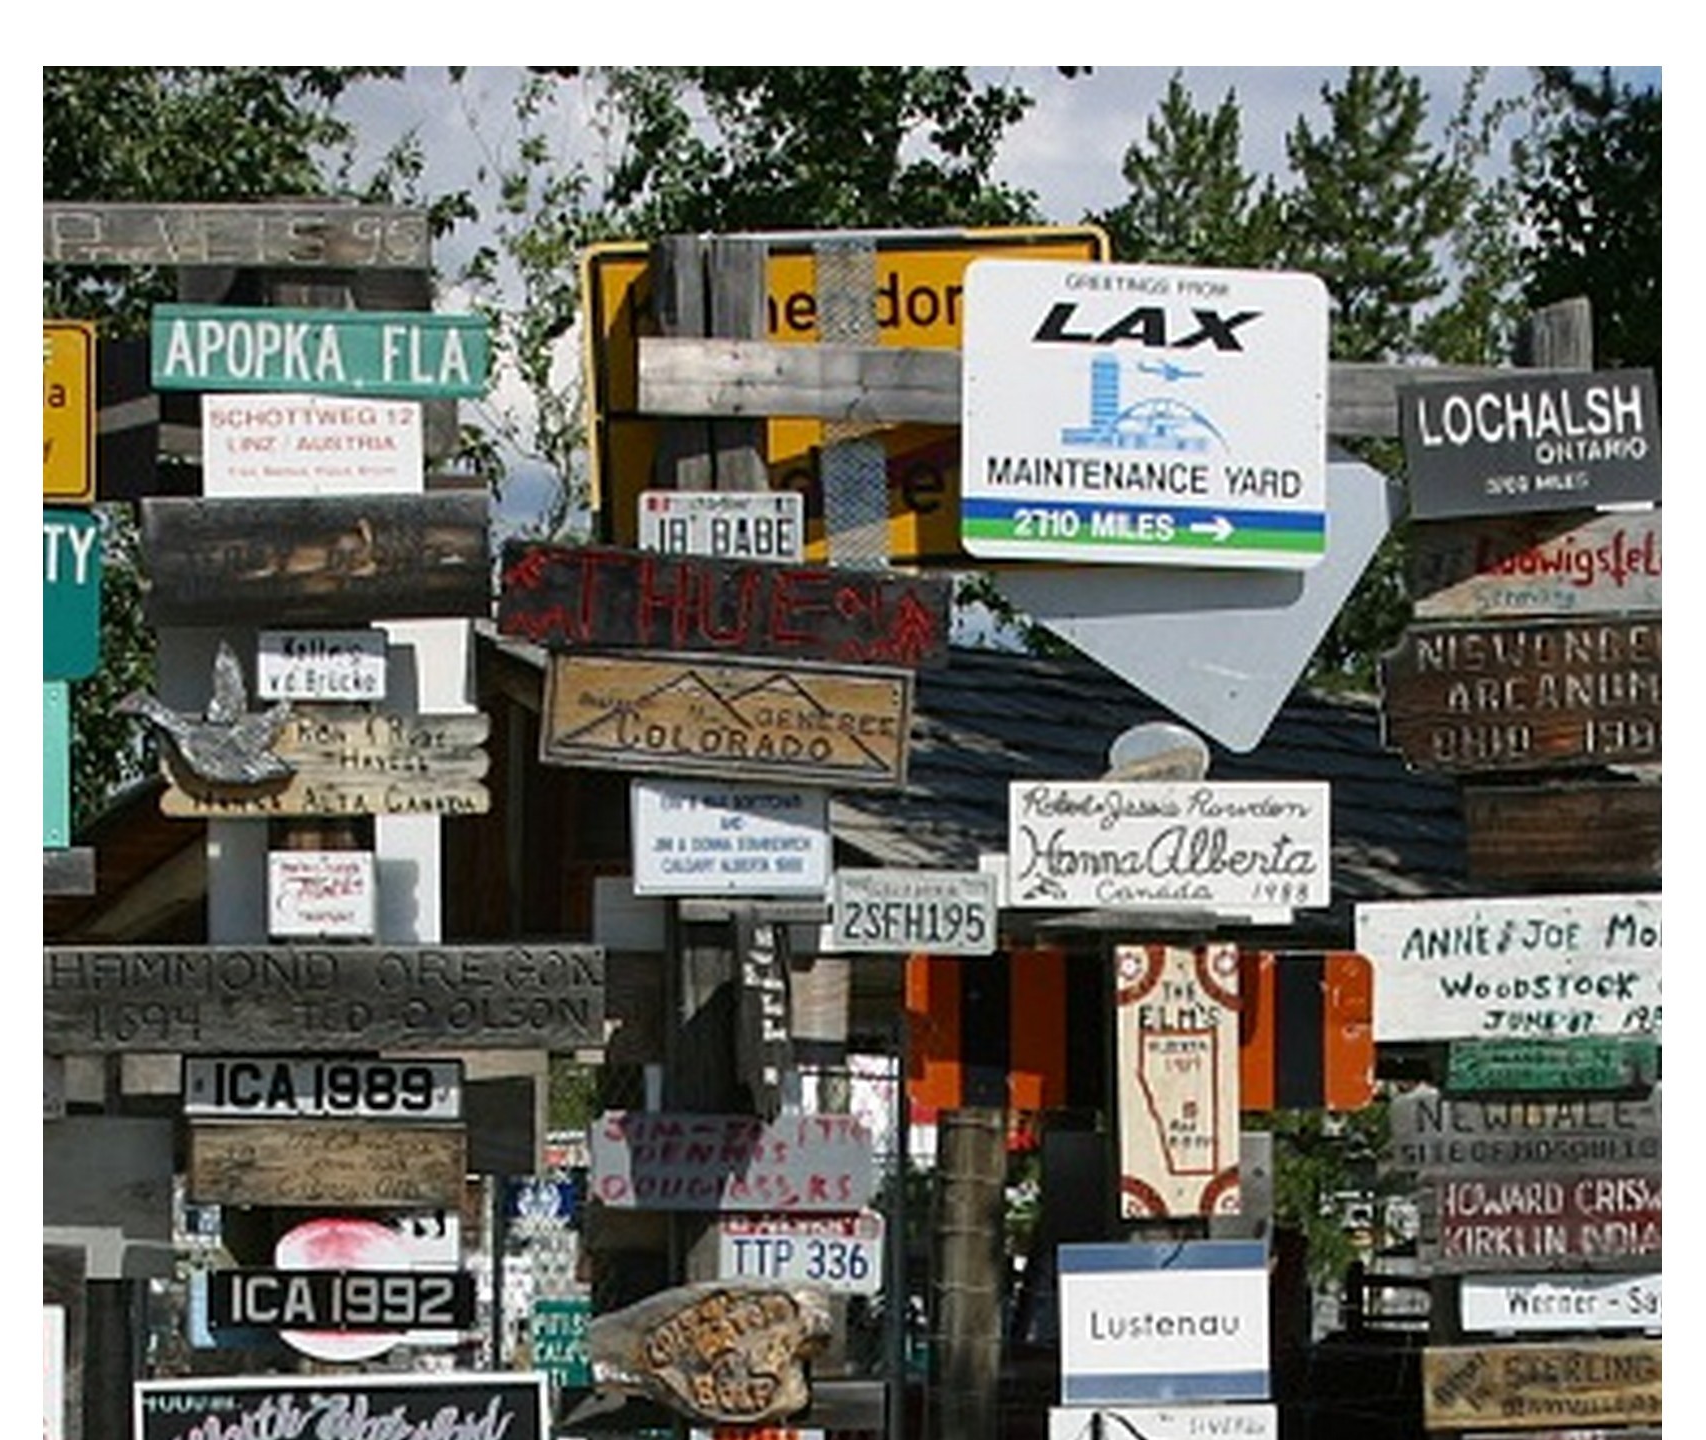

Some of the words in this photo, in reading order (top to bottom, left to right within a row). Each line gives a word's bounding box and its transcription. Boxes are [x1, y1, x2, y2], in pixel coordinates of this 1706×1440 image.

[1031, 302, 1264, 352] LAX
[383, 326, 471, 386] FLA
[1418, 384, 1643, 446] LOCHALSH
[1536, 436, 1648, 465] ONTARIO
[987, 457, 1208, 494] MAINTENANCE
[1225, 466, 1303, 498] YARD
[1013, 508, 1079, 537] 2710
[1090, 511, 1175, 541] MILES
[615, 708, 834, 763] COLORADO
[1146, 825, 1317, 876] Alberta
[1402, 924, 1490, 960] ANNE
[1522, 918, 1581, 950] JOE
[213, 1063, 301, 1109] ICA
[314, 1063, 434, 1109] 1989
[1438, 1182, 1564, 1216] HOWARD
[733, 1240, 792, 1275] TTP
[806, 1243, 869, 1280] 336
[1444, 1224, 1567, 1258] KIRKLIN
[231, 1275, 317, 1323] ICA
[331, 1276, 454, 1324] 1992
[1091, 1312, 1241, 1341] Lustenau
